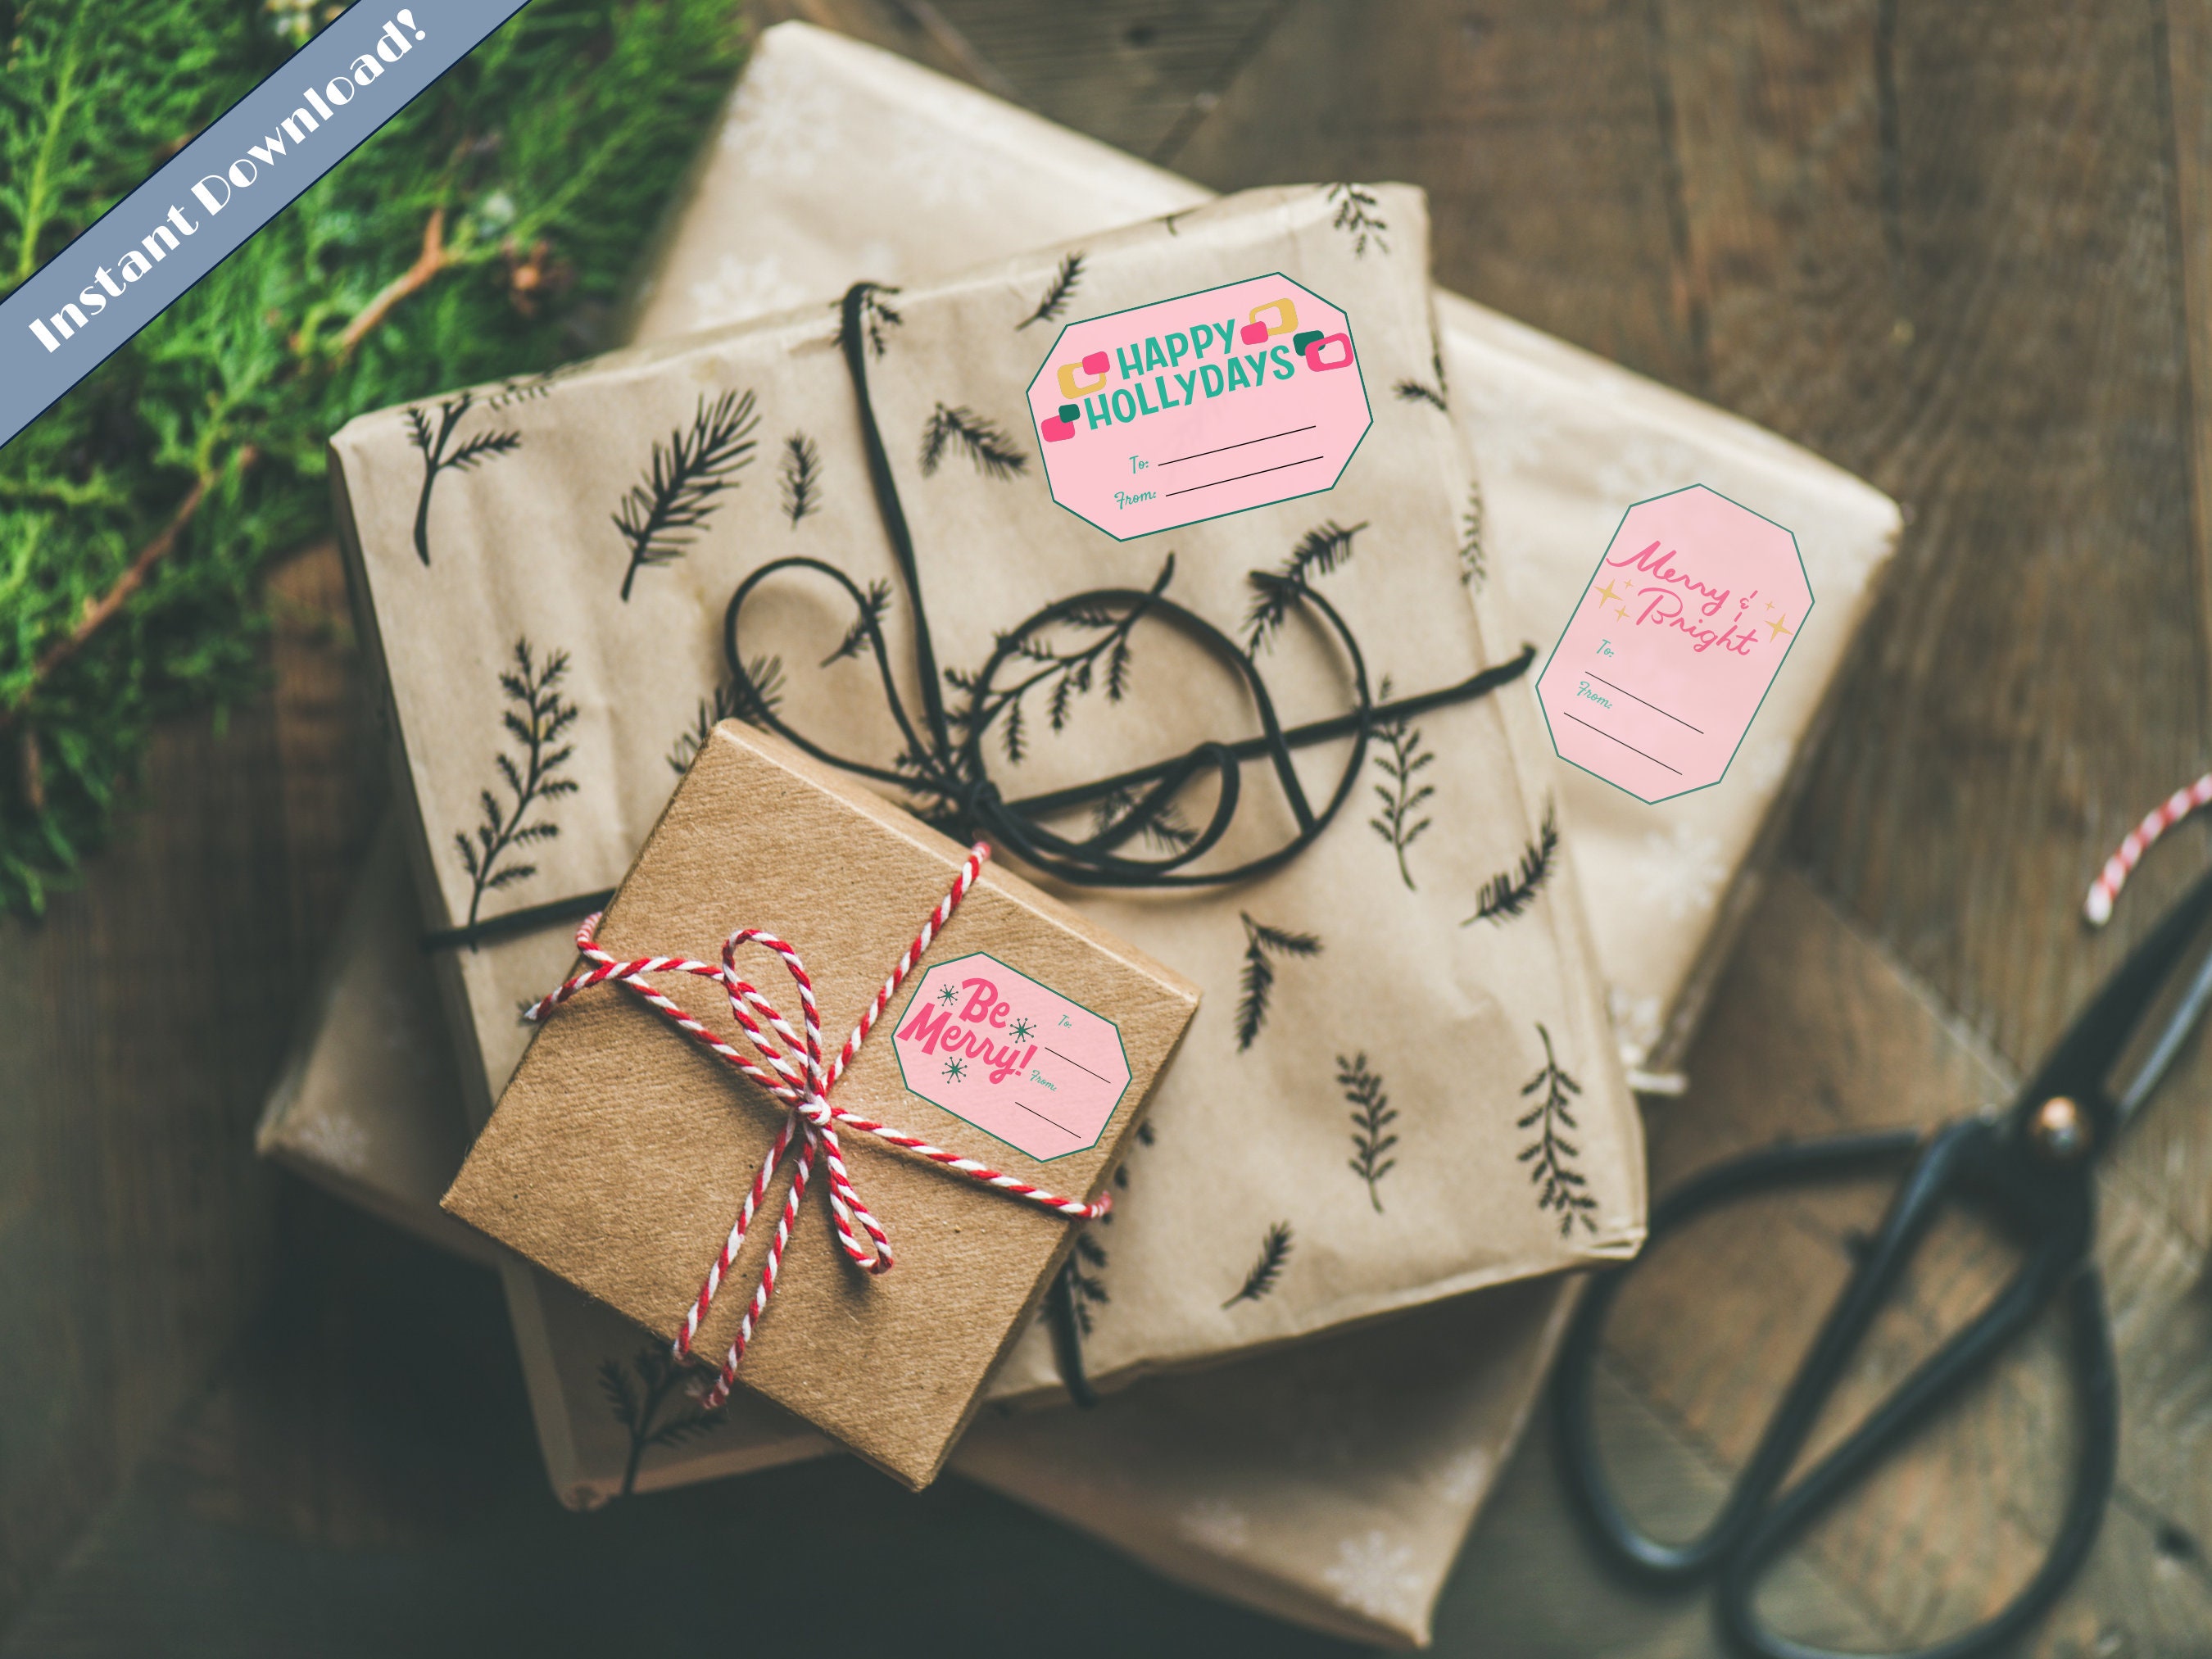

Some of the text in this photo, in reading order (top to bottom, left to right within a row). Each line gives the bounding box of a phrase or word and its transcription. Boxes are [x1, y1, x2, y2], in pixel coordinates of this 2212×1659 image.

[1116, 319, 1235, 380] HAPPY
[1084, 345, 1295, 430] HOLLYDAYS
[1129, 456, 1149, 474] To:
[1114, 492, 1157, 510] From:
[1606, 540, 1730, 616] Merry
[1636, 587, 1758, 655] Bright
[1595, 639, 1614, 658] To:
[1576, 681, 1612, 709] From:
[959, 977, 1010, 1029] Be
[1058, 1014, 1072, 1029] To:
[895, 1002, 1038, 1085] Merry!
[1030, 1069, 1057, 1091] From:
